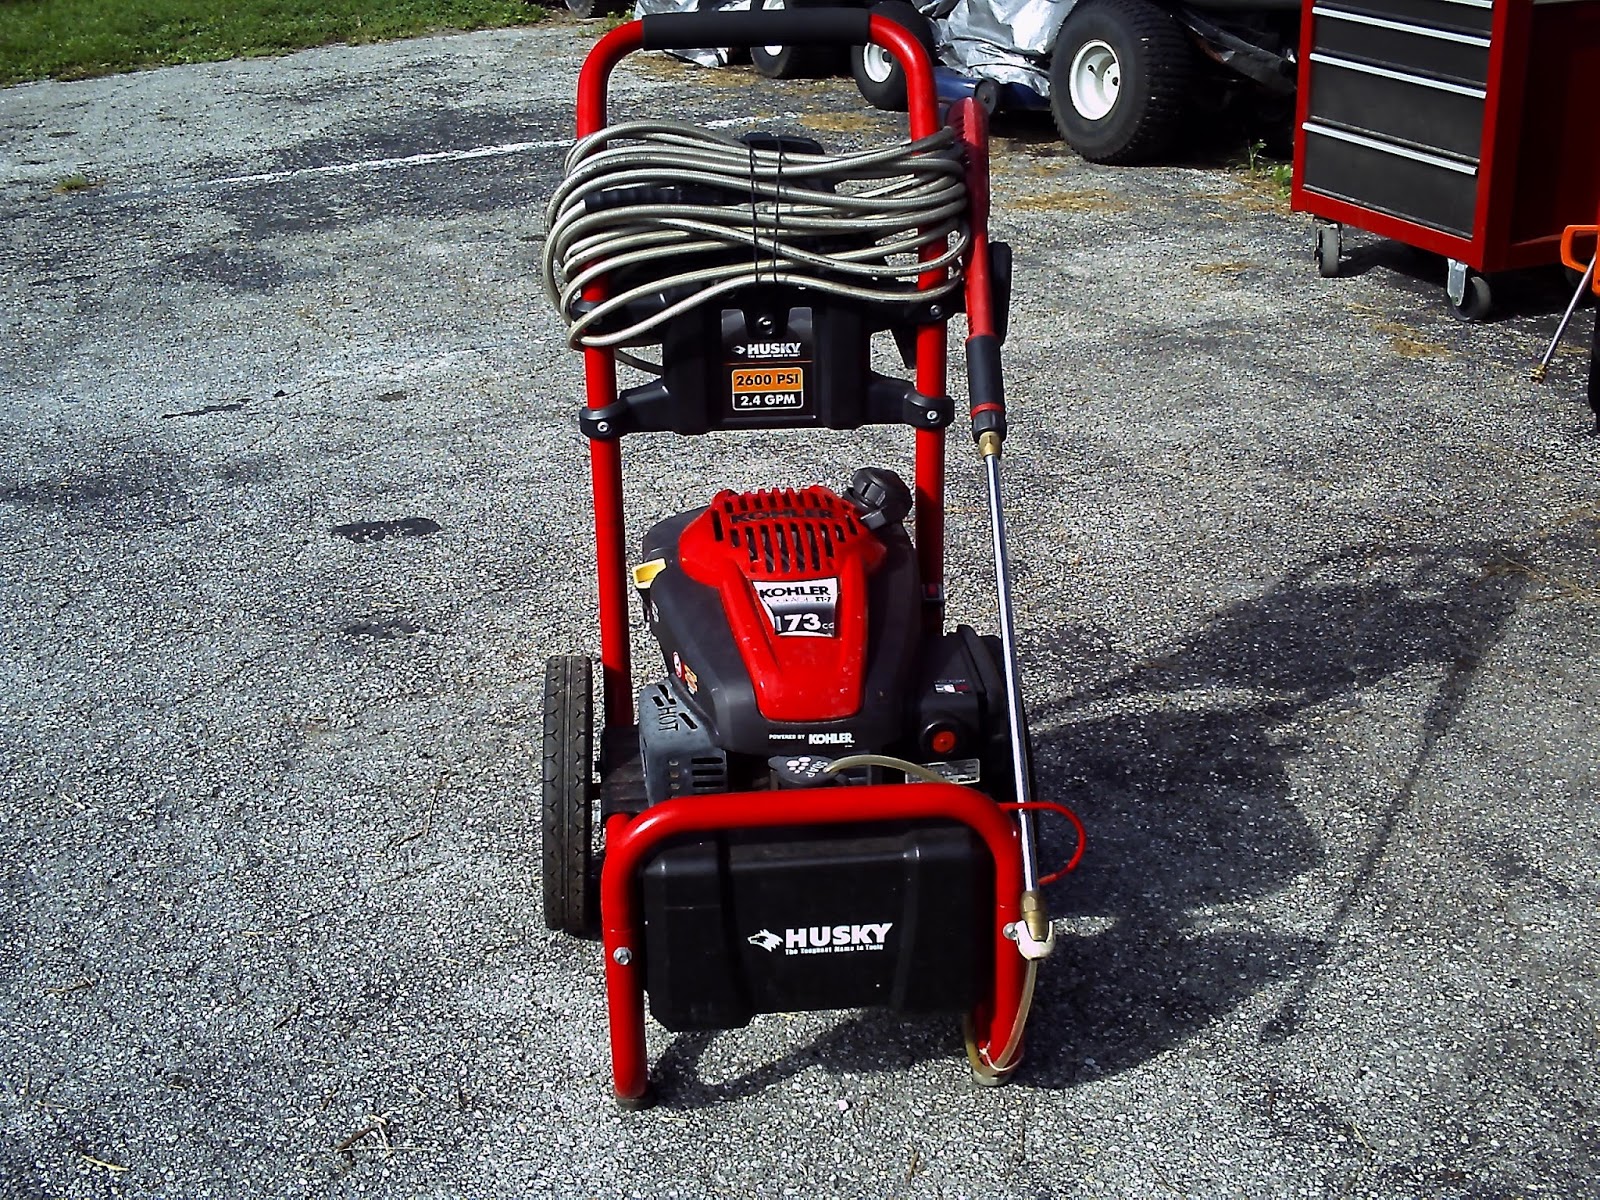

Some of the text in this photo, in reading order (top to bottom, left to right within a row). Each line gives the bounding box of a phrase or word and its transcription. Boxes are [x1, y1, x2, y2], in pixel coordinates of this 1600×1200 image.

[747, 342, 801, 354] HUSKY
[736, 374, 799, 386] 2600 PSI
[740, 394, 796, 406] 2.4 GPM
[759, 586, 831, 599] KOHLER
[658, 706, 679, 731] HOT
[808, 732, 855, 745] KOHLER
[805, 760, 828, 778] SOAP
[785, 922, 893, 949] HUSKY
